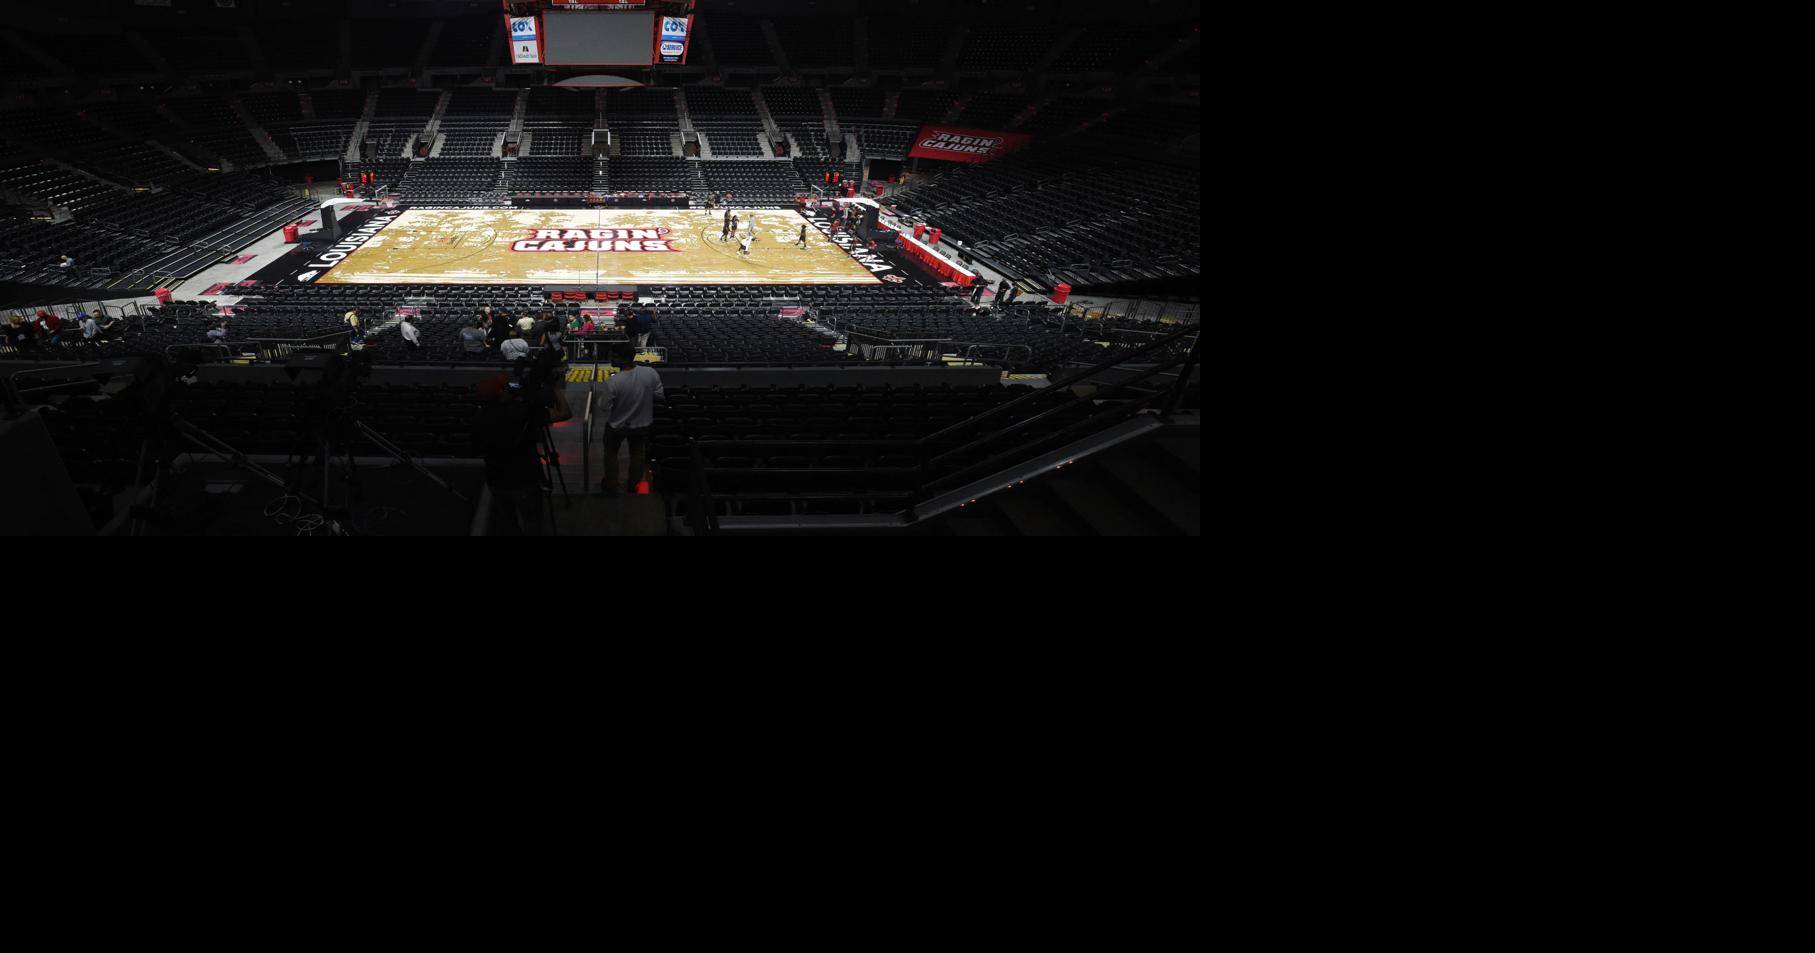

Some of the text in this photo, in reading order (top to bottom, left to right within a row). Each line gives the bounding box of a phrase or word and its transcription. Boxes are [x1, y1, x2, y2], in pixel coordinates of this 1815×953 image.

[922, 141, 990, 154] CAJUNS
[308, 215, 397, 268] LOUISIANA
[512, 239, 671, 251] CAJUNS
